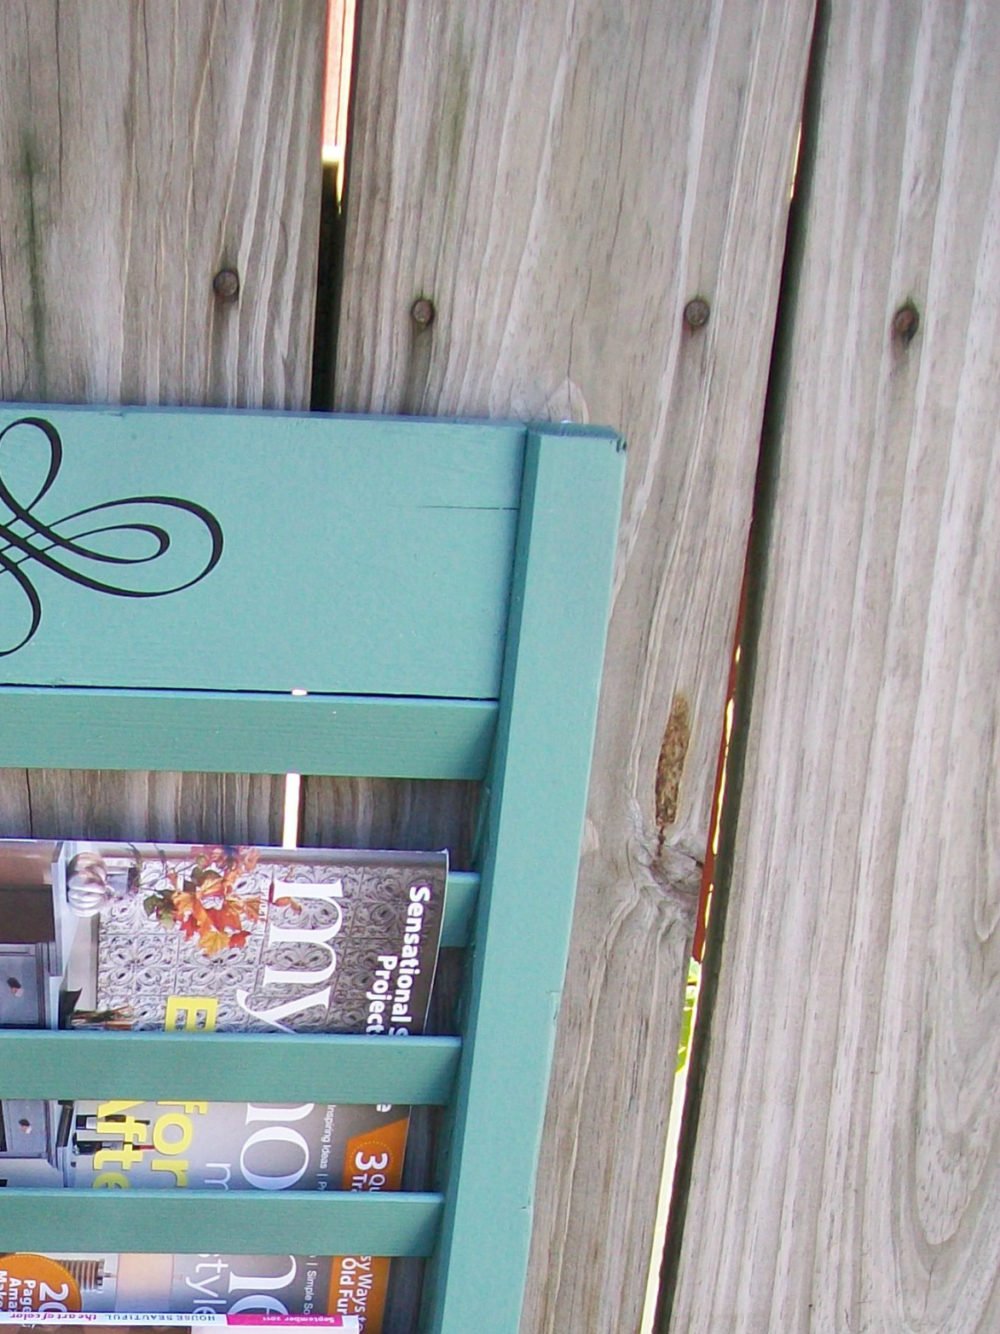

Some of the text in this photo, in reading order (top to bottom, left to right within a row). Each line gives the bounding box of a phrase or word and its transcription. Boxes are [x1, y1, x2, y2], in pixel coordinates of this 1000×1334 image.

[236, 879, 344, 1035] my
[390, 886, 430, 1023] Sensational
[365, 956, 398, 1036] Project
[320, 1104, 336, 1143] Inspiring
[318, 1144, 332, 1170] Ideas
[354, 1151, 389, 1171] 3
[22, 1280, 37, 1312] Page
[303, 1270, 318, 1301] Simple
[336, 1257, 357, 1315] Old Fur
[351, 1274, 374, 1313] Ways
[10, 1312, 40, 1320] color
[41, 1312, 55, 1320] of
[77, 1313, 97, 1321] the
[105, 1313, 173, 1321] BEAUTIFUL
[176, 1314, 216, 1322] HOUSE
[284, 1315, 335, 1323] September
